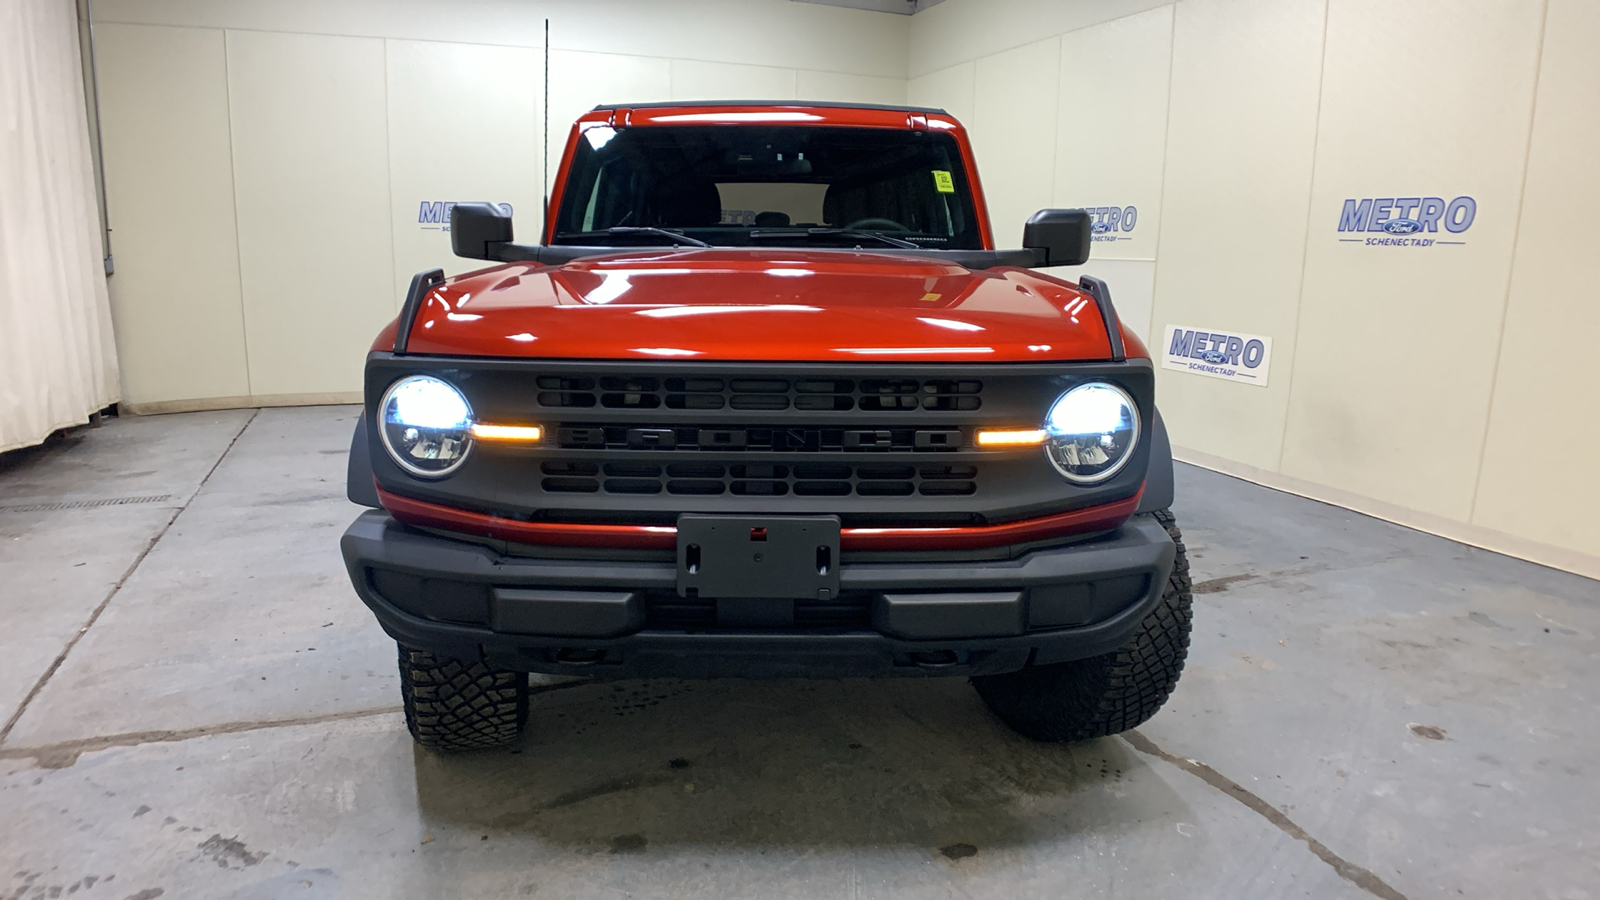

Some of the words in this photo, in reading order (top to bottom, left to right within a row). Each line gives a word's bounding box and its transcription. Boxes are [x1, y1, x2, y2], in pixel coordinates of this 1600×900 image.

[418, 201, 514, 224] MEO
[1085, 205, 1138, 232] TRO
[1337, 196, 1477, 234] METRO
[1388, 222, 1414, 233] Ford
[1365, 237, 1436, 247] SCHENECTADY
[1169, 328, 1265, 369] METRO
[1204, 352, 1223, 364] Ford
[1188, 362, 1237, 377] SCHENECTADY
[557, 427, 963, 450] BRONCO
